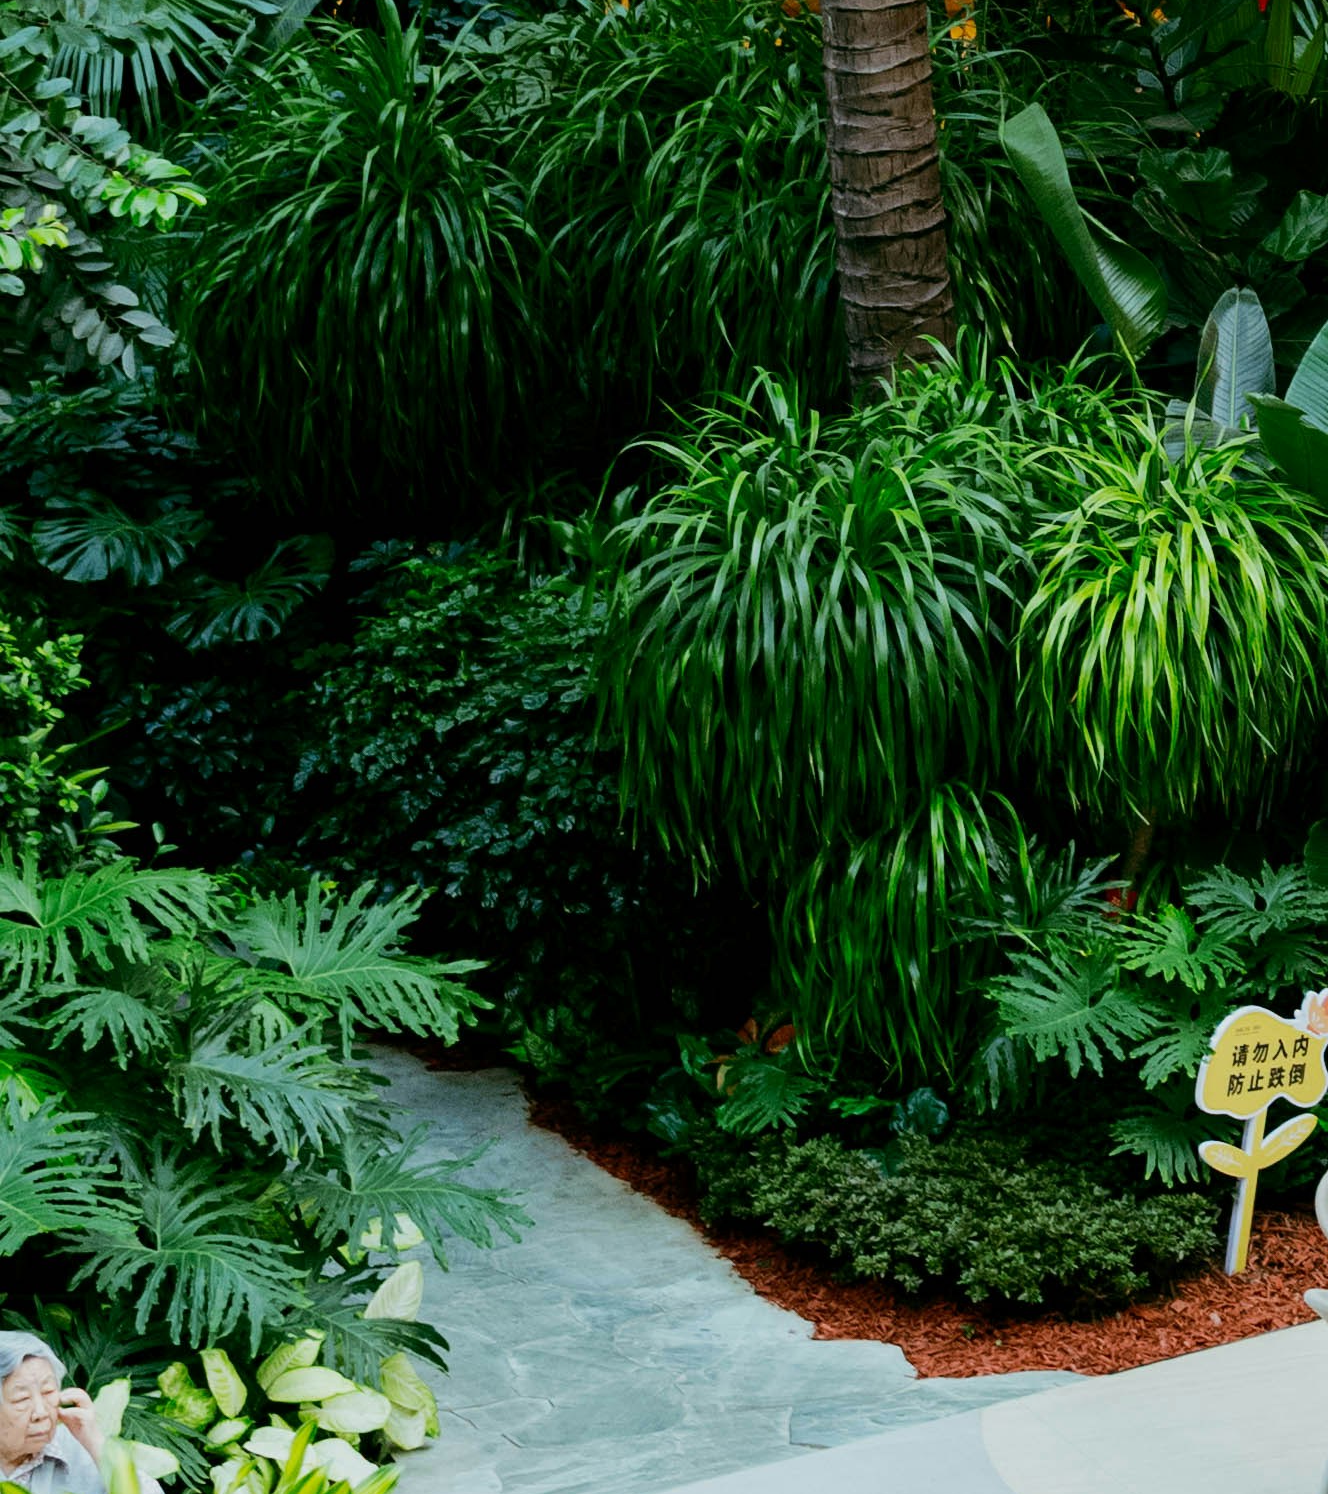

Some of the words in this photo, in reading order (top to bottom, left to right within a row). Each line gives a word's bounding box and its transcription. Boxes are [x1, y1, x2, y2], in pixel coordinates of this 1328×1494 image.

[1232, 1034, 1310, 1067] 请勿入内
[1226, 1063, 1306, 1097] 防止跌倒
